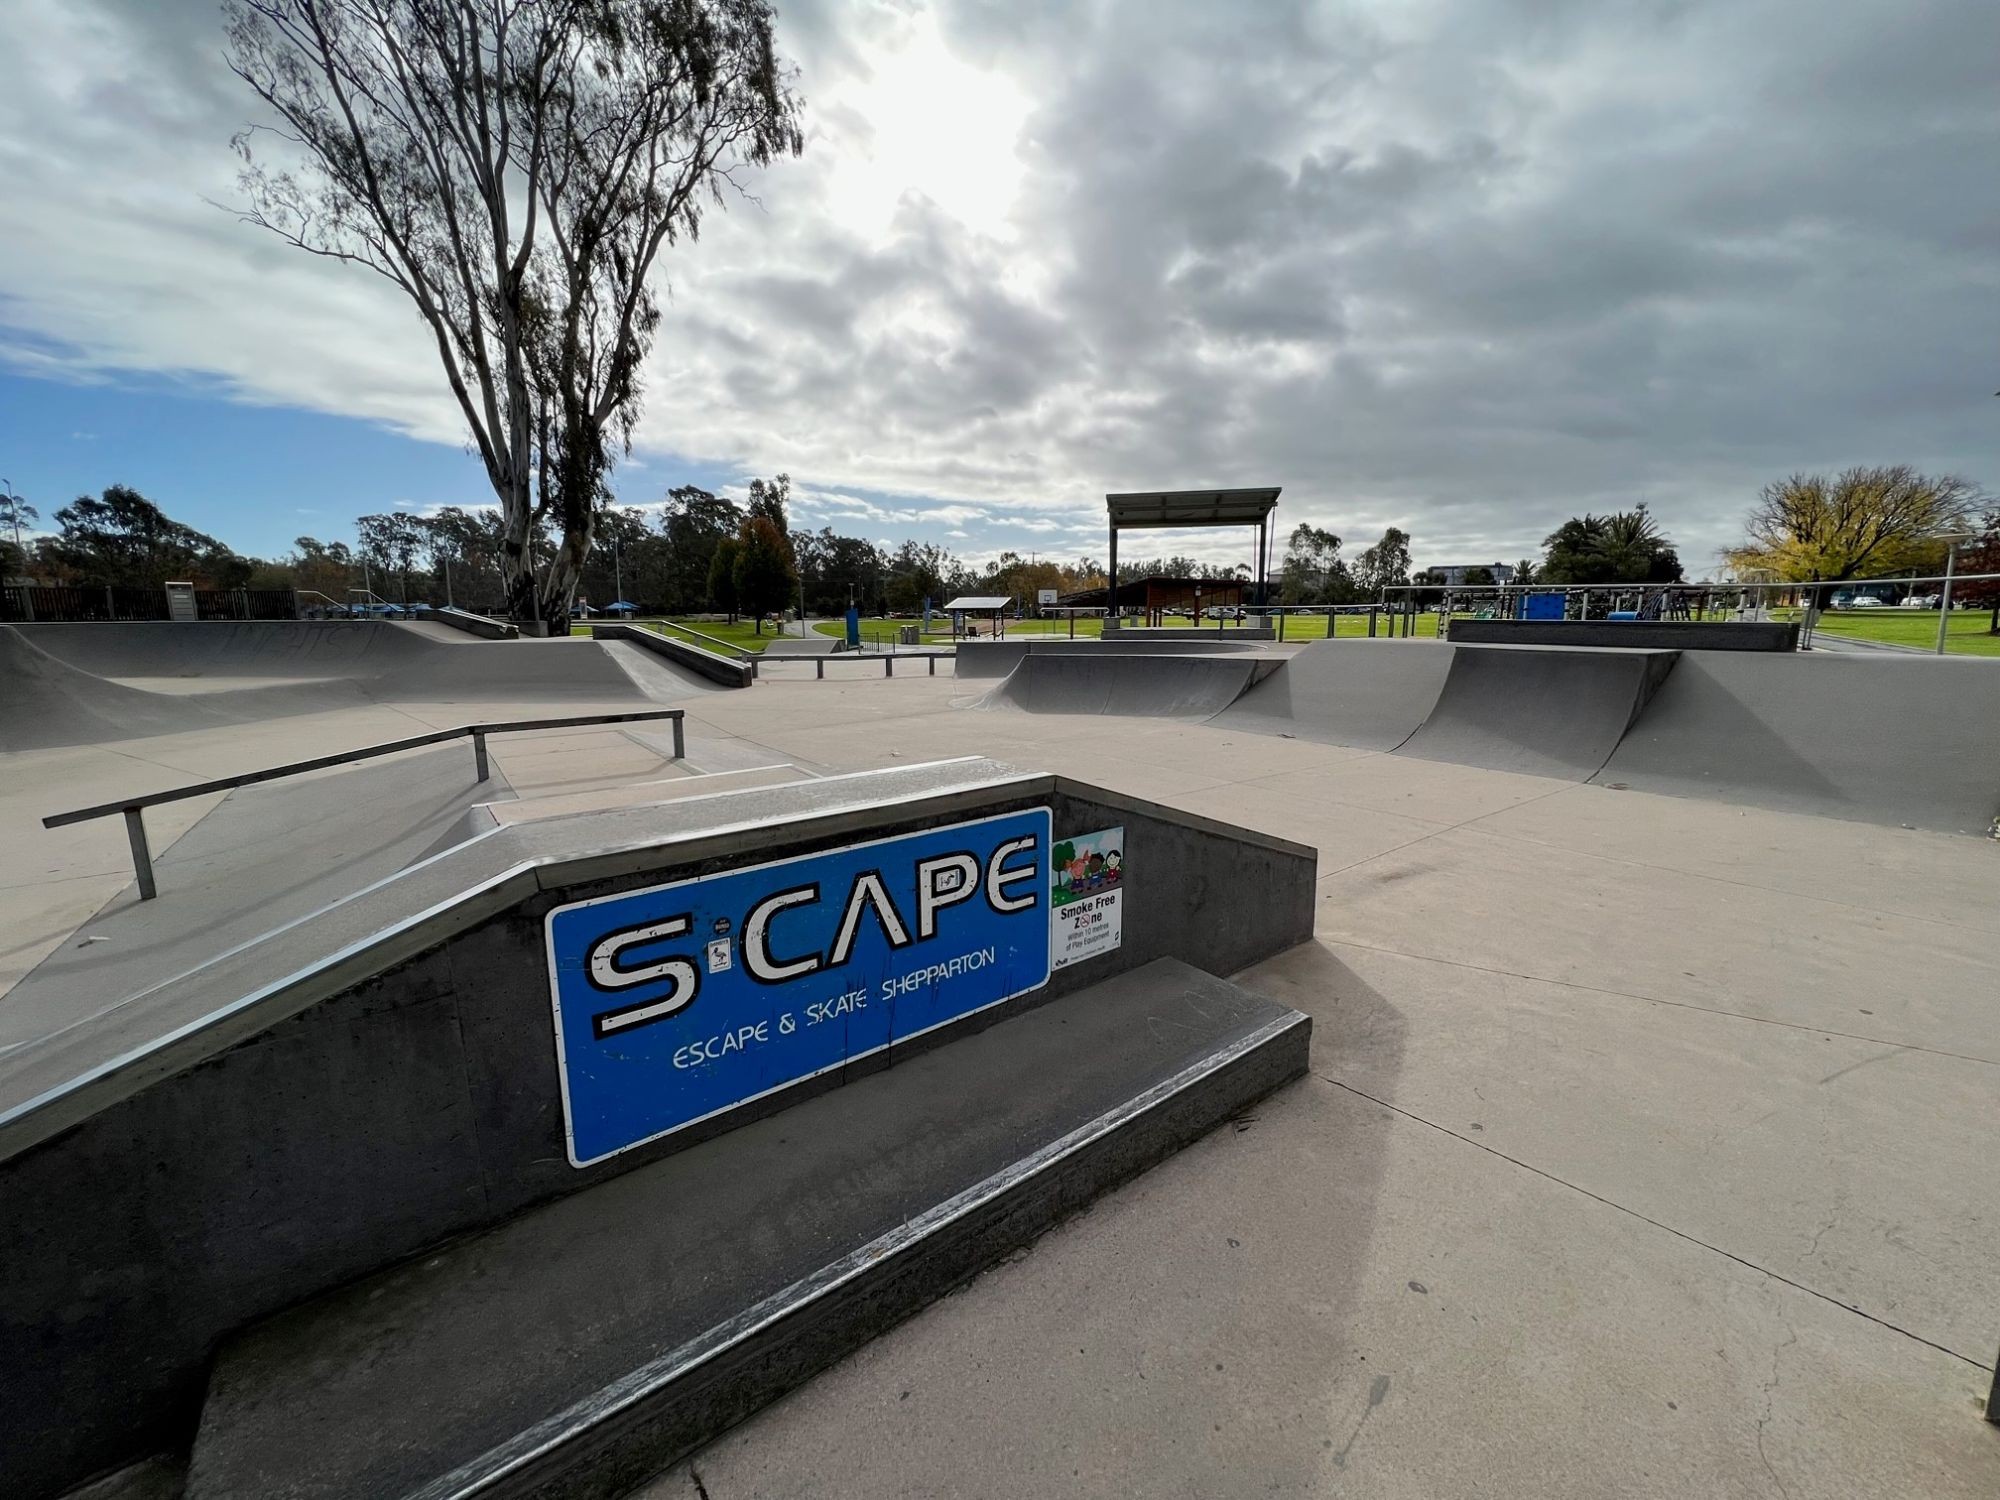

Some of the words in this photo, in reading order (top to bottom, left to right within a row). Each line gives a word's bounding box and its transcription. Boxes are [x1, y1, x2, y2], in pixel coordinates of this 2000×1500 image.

[1061, 902, 1093, 920] Smoke
[1096, 895, 1115, 909] Free
[1066, 944, 1071, 952] of
[1072, 941, 1083, 949] Play
[1084, 930, 1109, 946] Equipment
[1085, 927, 1091, 935] 10
[673, 1020, 769, 1069] ESCAPE
[779, 1013, 796, 1035] &
[806, 988, 867, 1026] SKATE
[882, 946, 995, 1001] SHEPPARTON
